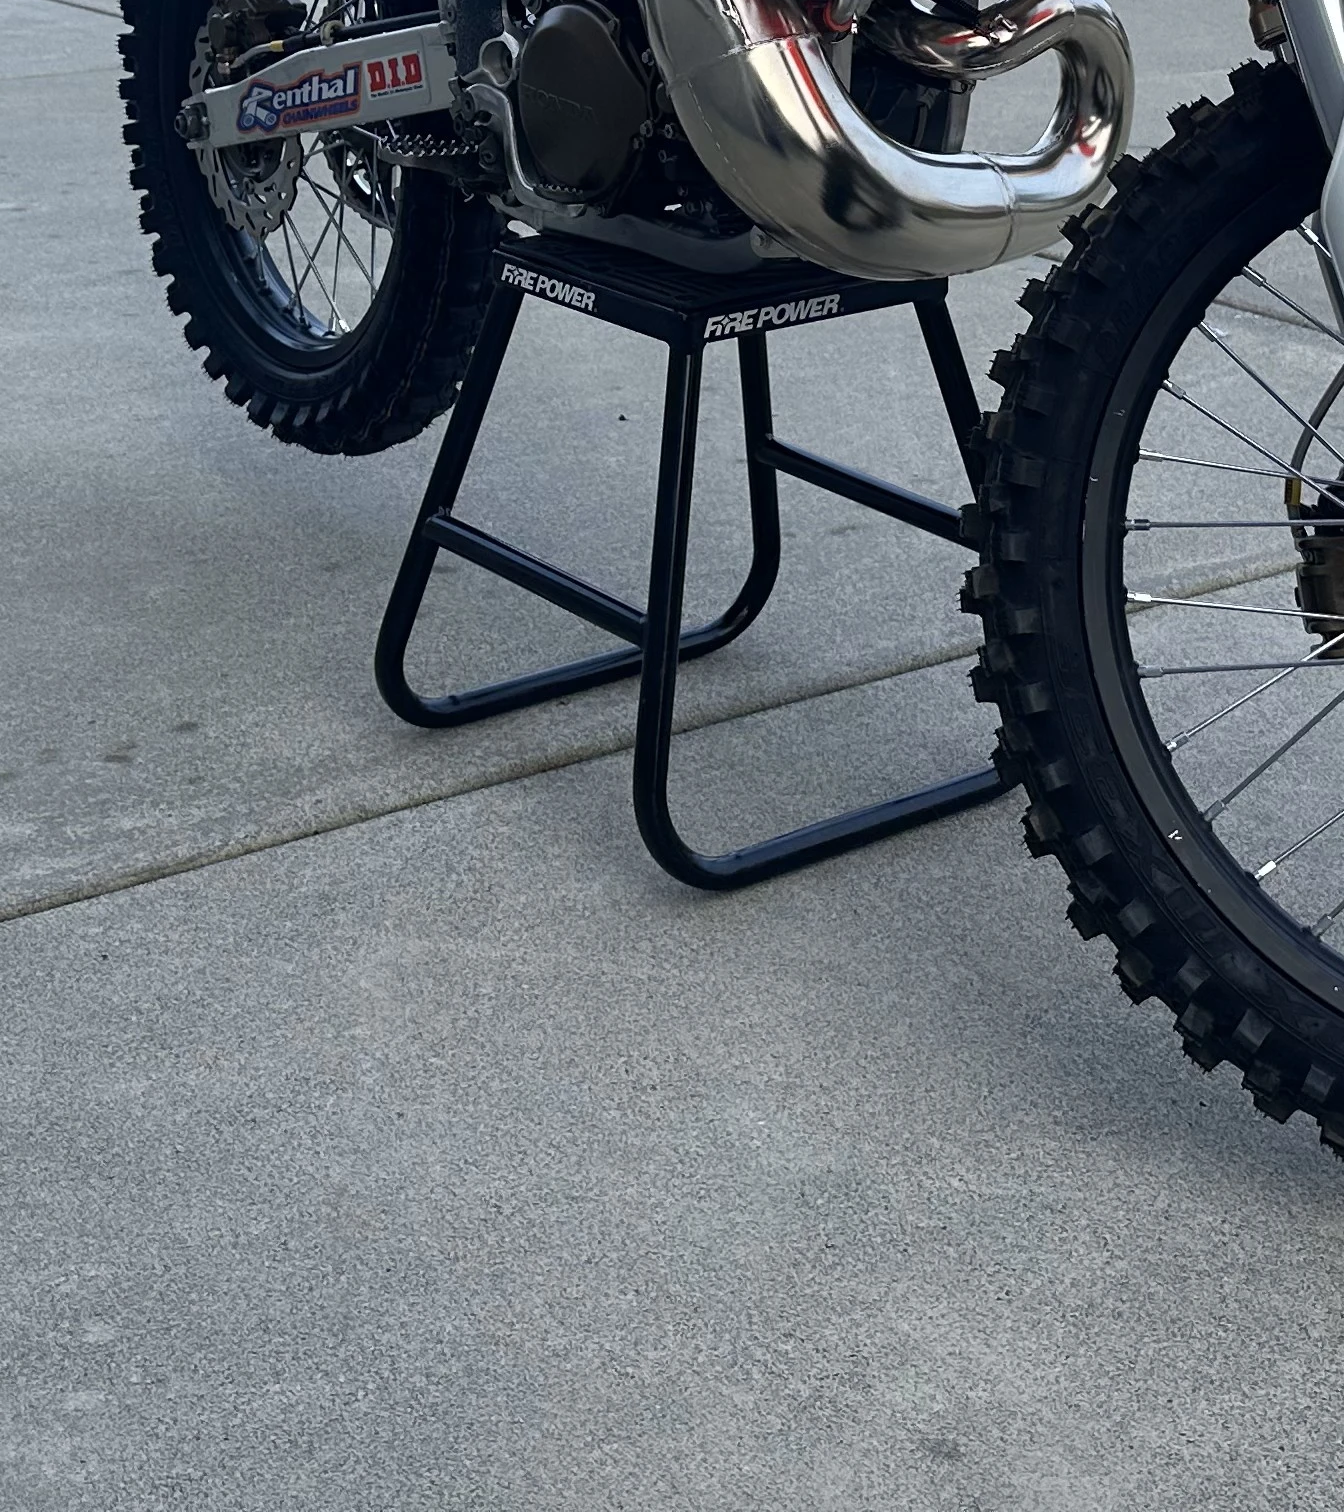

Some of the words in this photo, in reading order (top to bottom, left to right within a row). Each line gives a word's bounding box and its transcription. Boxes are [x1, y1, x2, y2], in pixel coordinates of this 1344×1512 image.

[366, 53, 423, 93] D.I.D
[241, 68, 356, 128] Renthal
[501, 263, 535, 289] FIRE
[535, 273, 596, 312] POWER
[703, 308, 758, 339] FIRE
[757, 293, 841, 331] POWER
